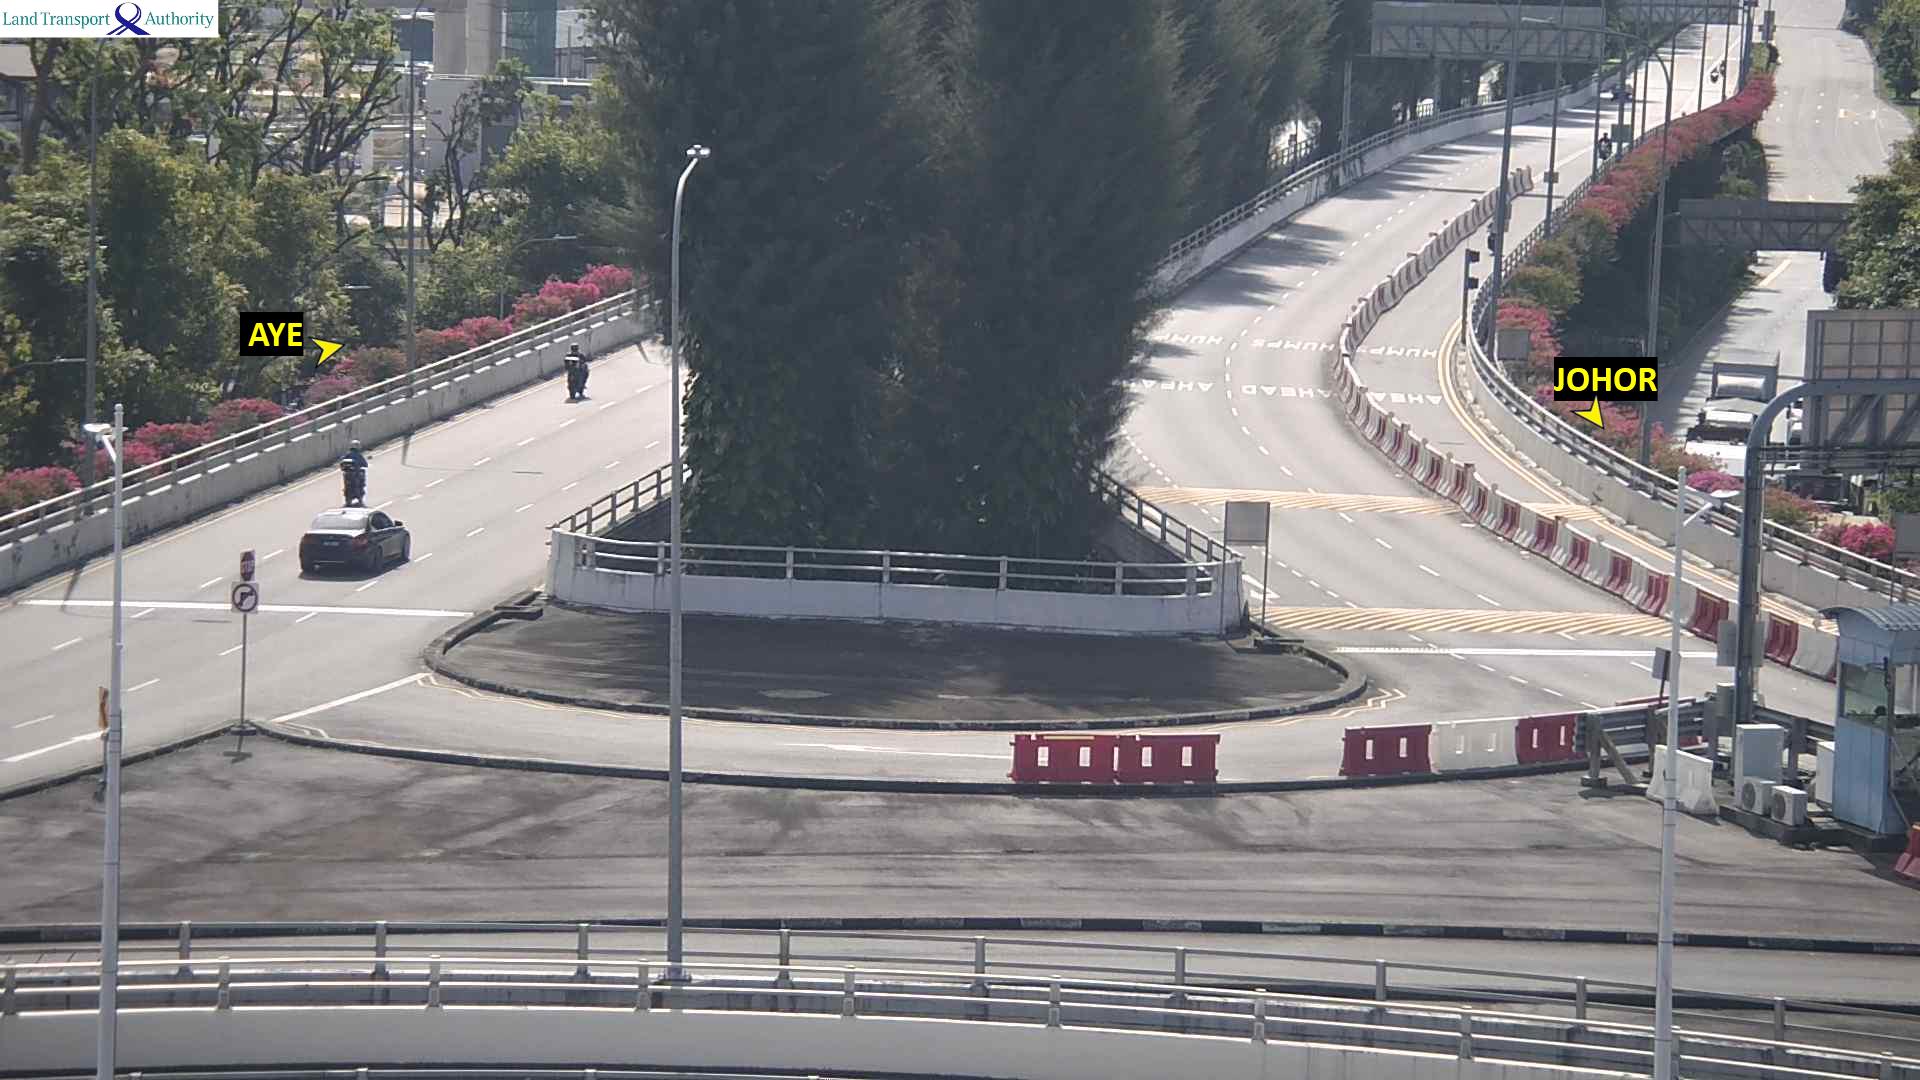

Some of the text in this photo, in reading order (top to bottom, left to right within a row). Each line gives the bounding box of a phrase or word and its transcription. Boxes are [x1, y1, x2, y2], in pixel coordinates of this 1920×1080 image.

[1250, 339, 1335, 351] HUMPS
[1242, 384, 1333, 398] AHEAD
[1367, 392, 1442, 405] AHEA
